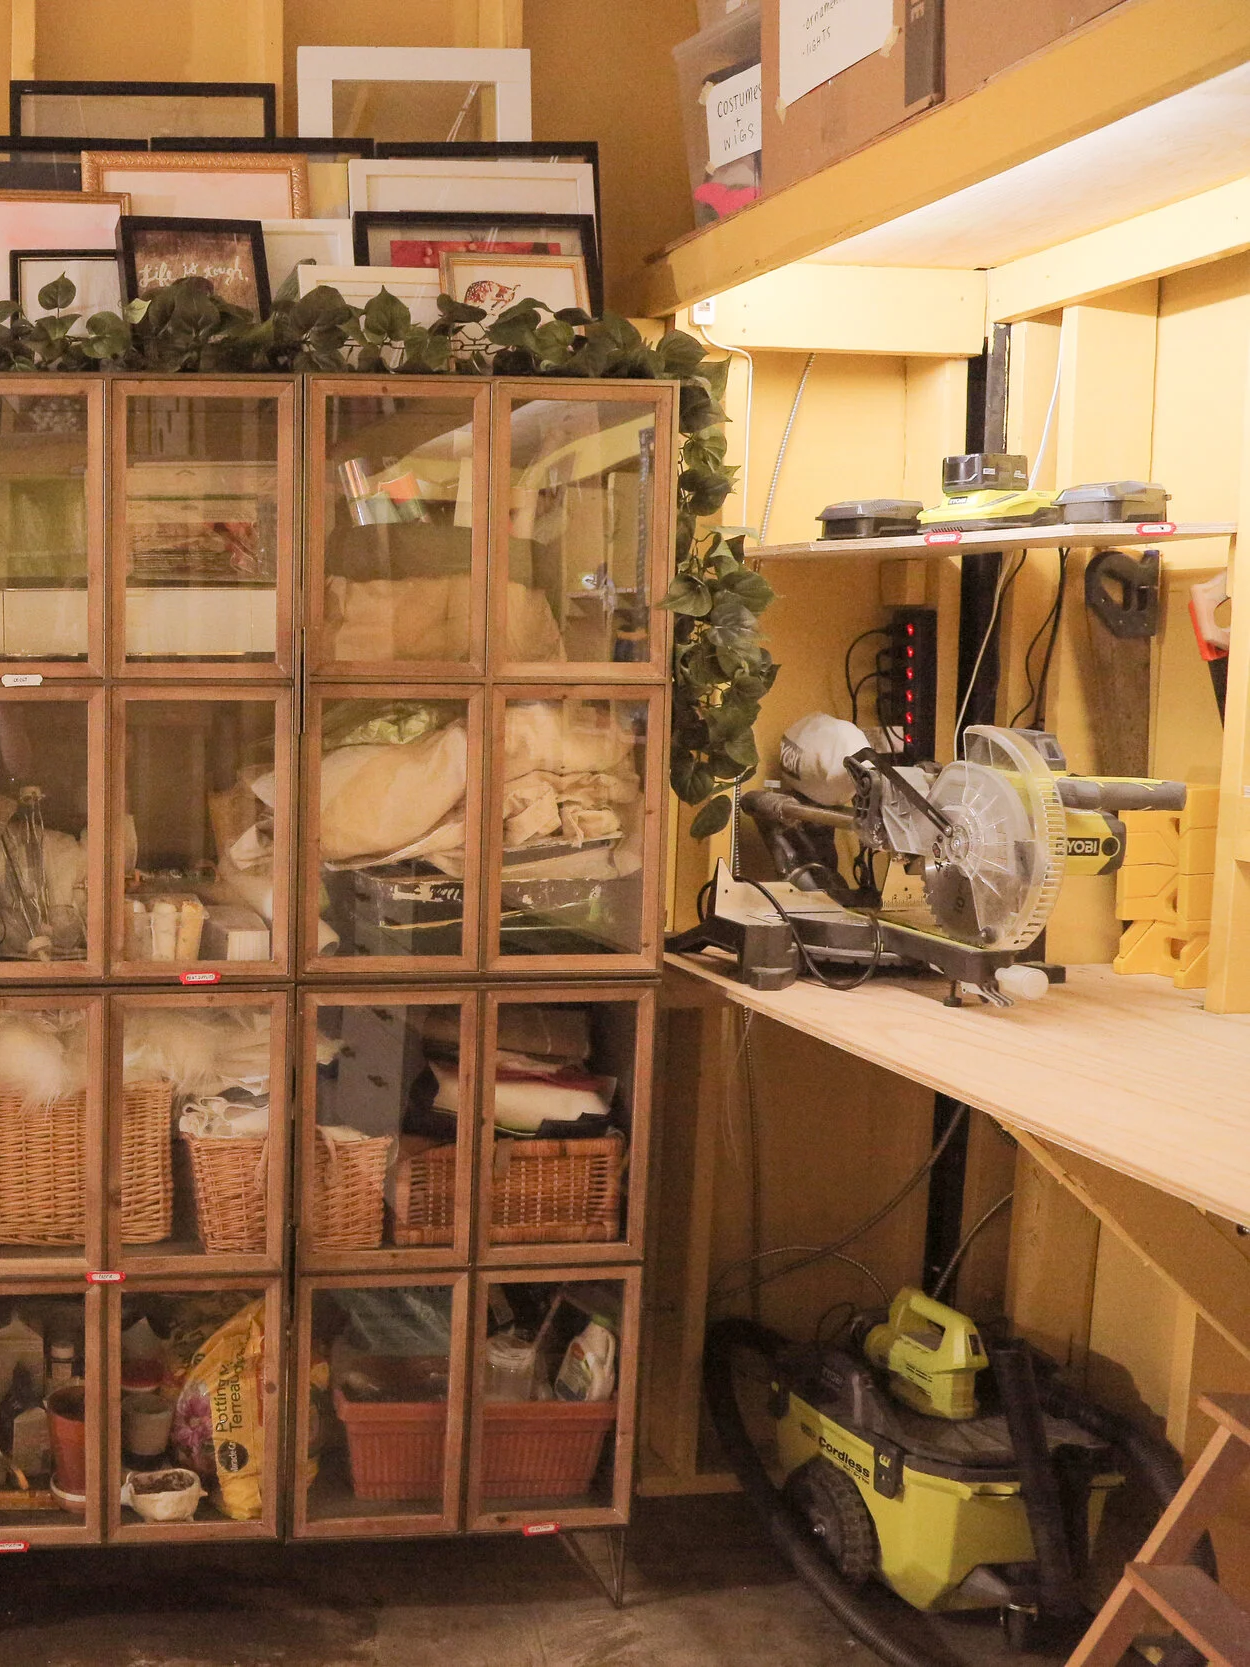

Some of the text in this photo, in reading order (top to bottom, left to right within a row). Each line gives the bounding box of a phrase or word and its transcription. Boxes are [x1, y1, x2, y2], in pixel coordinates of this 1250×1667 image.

[1054, 840, 1098, 854] YOBI
[214, 1379, 229, 1432] Potting
[818, 1435, 870, 1478] Cordless
